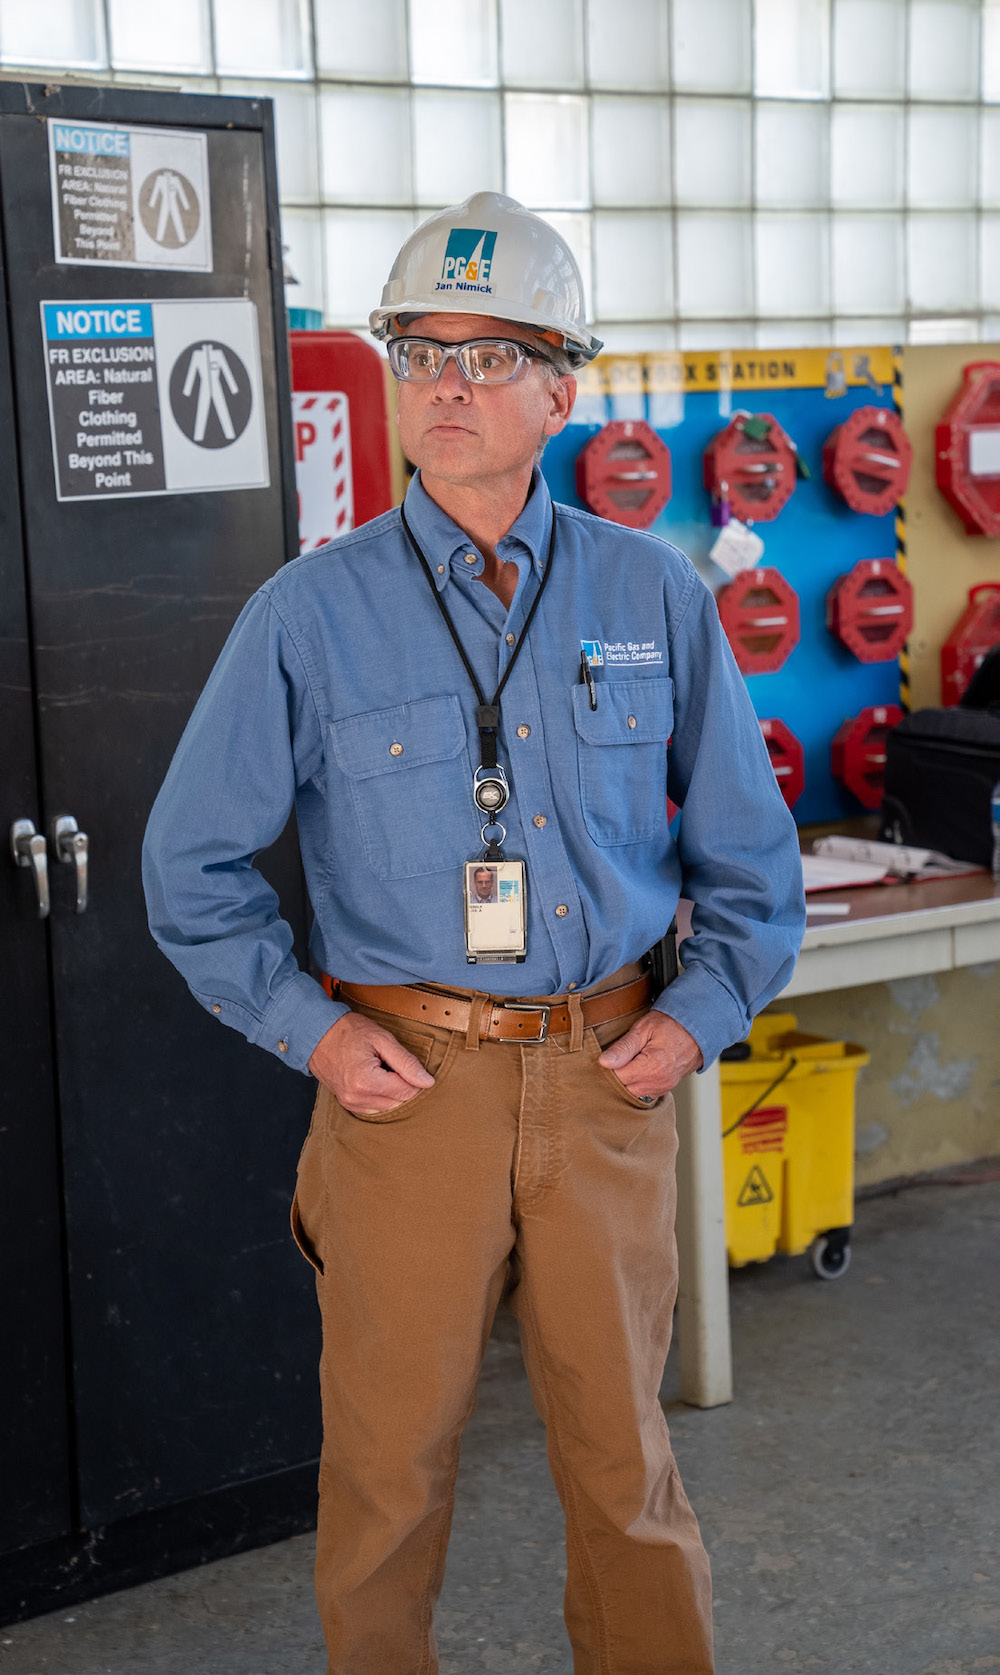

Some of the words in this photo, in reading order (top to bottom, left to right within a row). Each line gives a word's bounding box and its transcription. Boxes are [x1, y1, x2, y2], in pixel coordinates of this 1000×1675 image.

[56, 129, 129, 154] NOTICE
[58, 164, 73, 176] FR
[74, 166, 128, 180] EXCLUSION
[62, 179, 92, 191] AREA:
[94, 182, 127, 194] Natural
[63, 194, 87, 205] Fiber
[88, 195, 127, 211] Clothing
[74, 209, 118, 223] Permitted
[79, 224, 114, 238] Beyond
[74, 237, 94, 249] This
[97, 239, 120, 250] Point
[443, 256, 491, 281] PG&E
[435, 282, 453, 291] Jan
[455, 282, 492, 294] Nimick
[56, 310, 142, 334] NOTICE
[50, 349, 69, 364] FR
[73, 346, 154, 364] EXCLUSION
[55, 369, 100, 385] AREA:
[104, 368, 153, 383] Natural
[706, 359, 796, 382] STATION
[89, 390, 124, 405] Fiber
[79, 410, 137, 428] Clothing
[77, 429, 142, 447] Permitted
[68, 452, 121, 471] Beyond
[124, 450, 154, 465] This
[95, 472, 132, 488] Point
[604, 642, 626, 652] Pacific
[627, 642, 640, 651] Gas
[641, 640, 655, 650] and
[606, 652, 630, 661] Electric
[631, 651, 662, 660] Company
